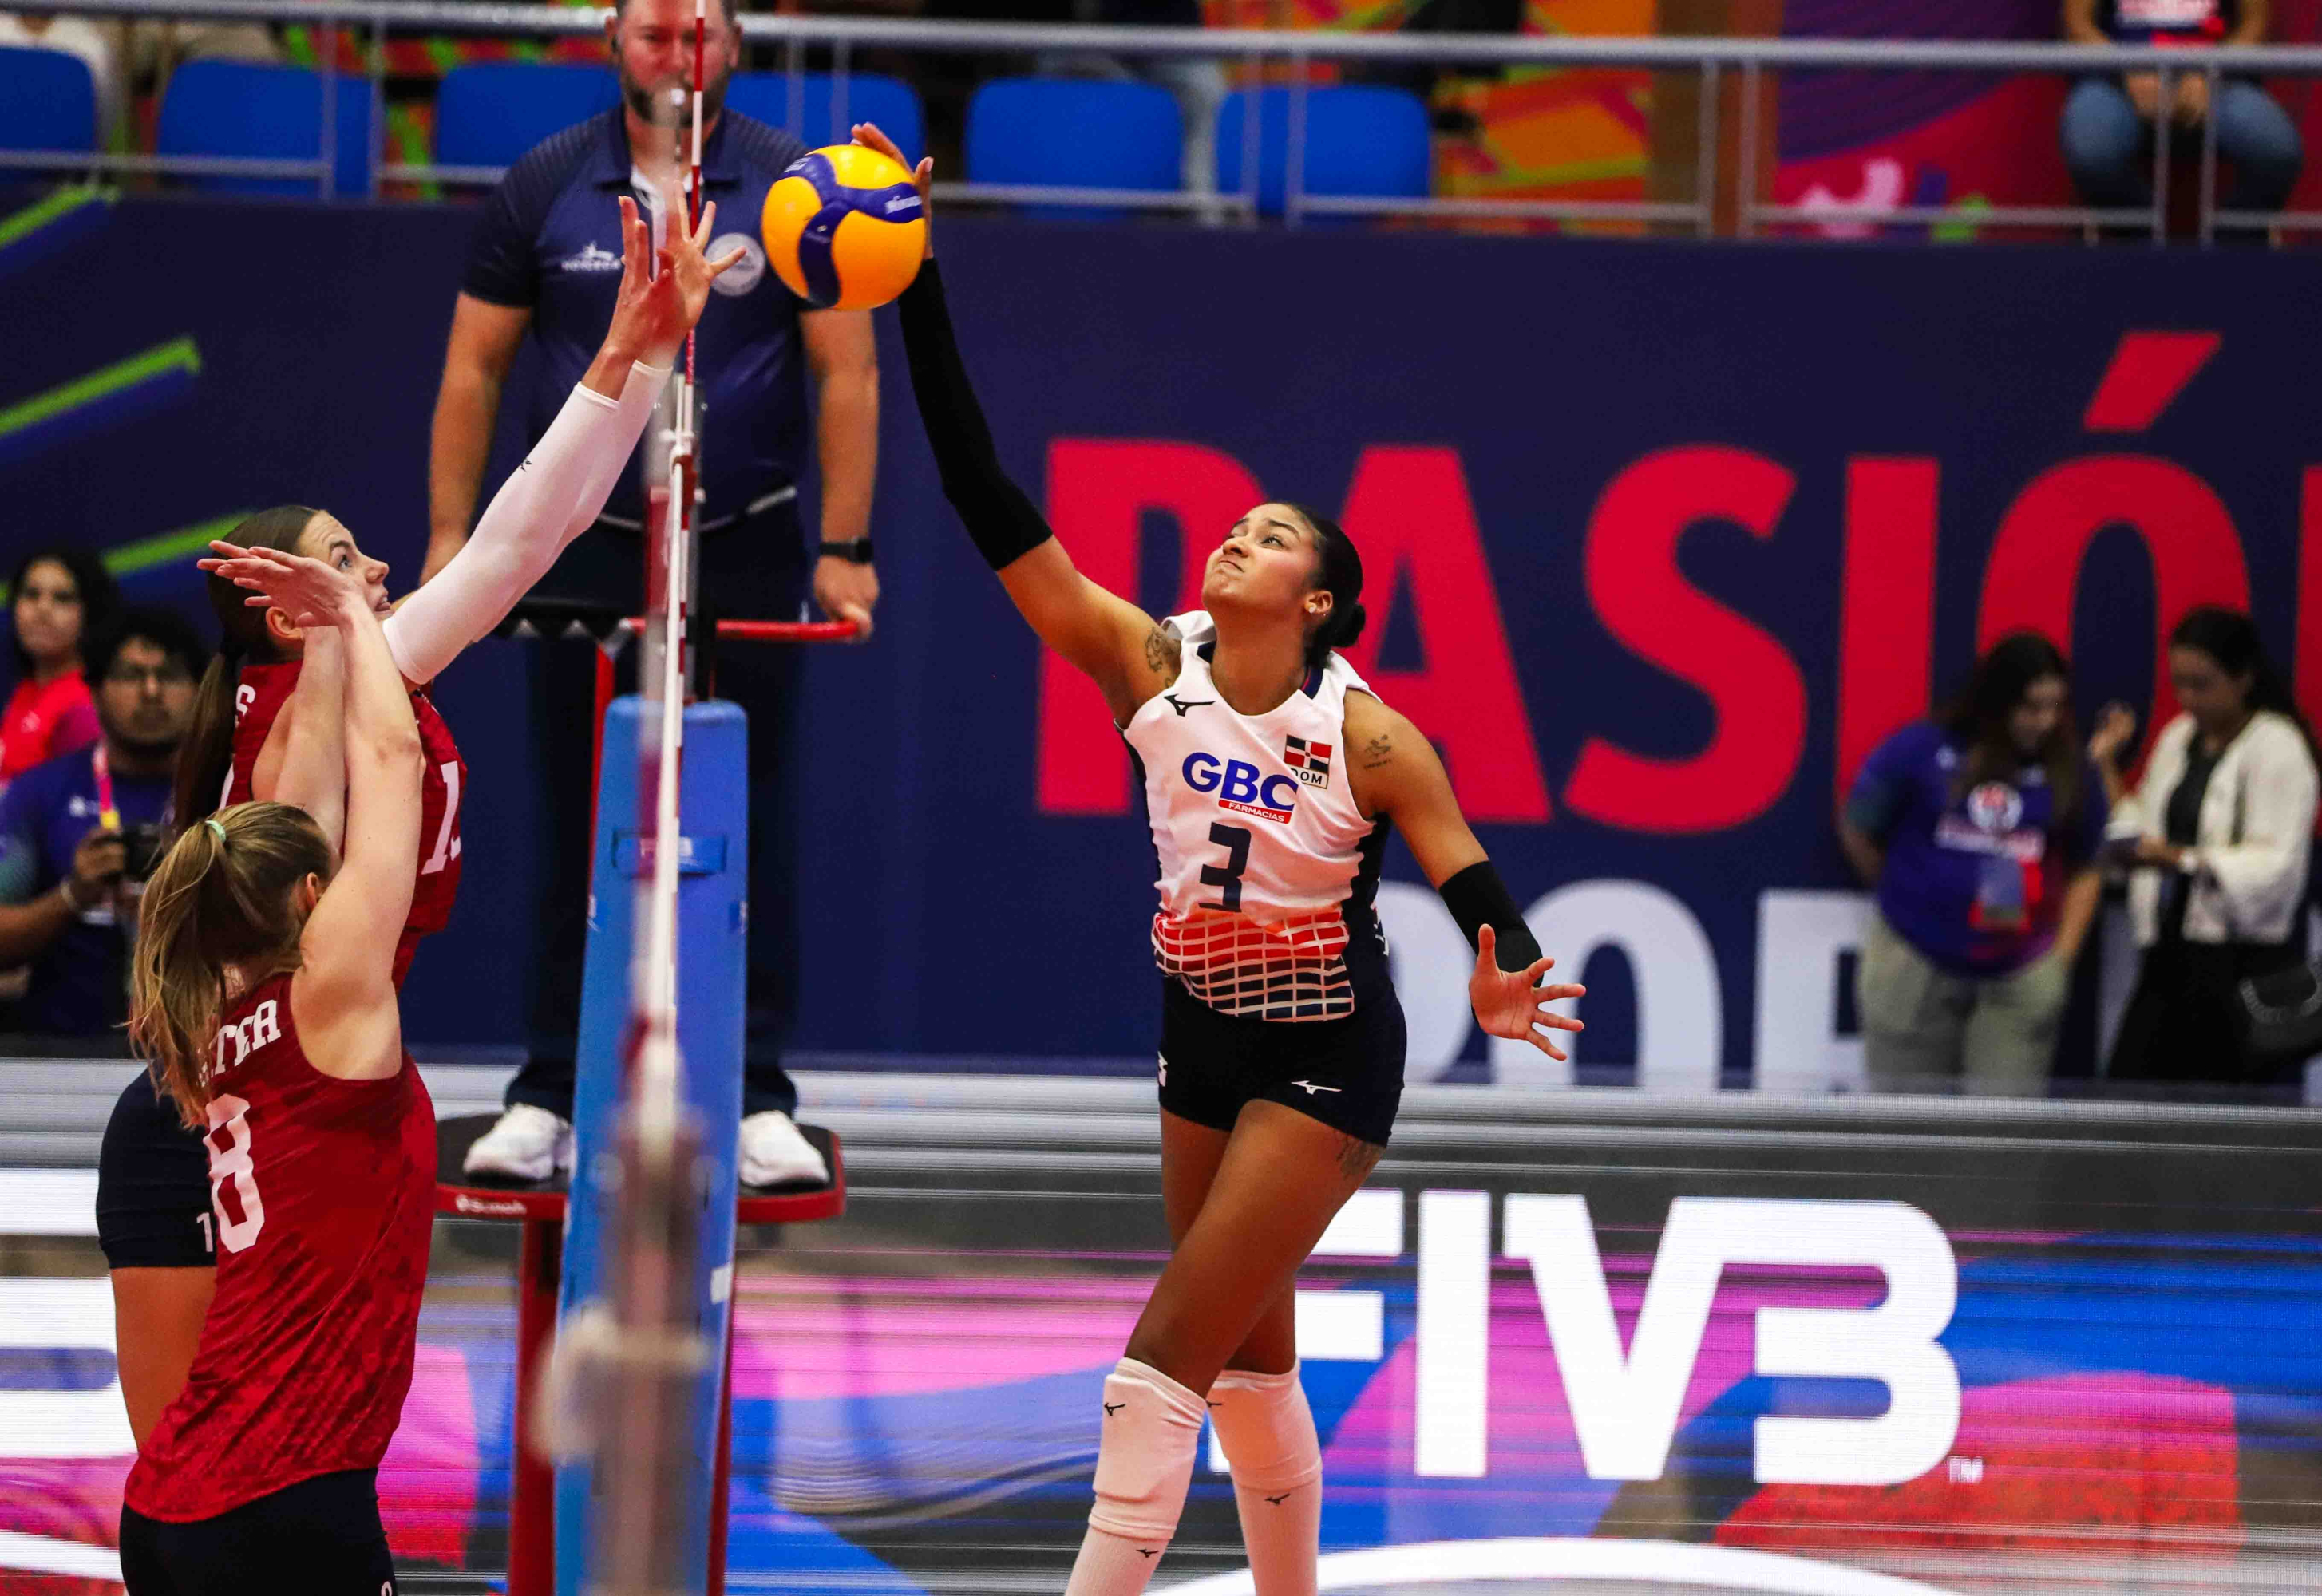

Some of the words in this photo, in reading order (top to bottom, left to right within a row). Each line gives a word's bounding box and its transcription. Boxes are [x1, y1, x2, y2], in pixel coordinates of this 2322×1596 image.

[1038, 330, 2322, 833] PASIÓ
[1182, 752, 1299, 812] GBC
[1228, 803, 1285, 823] FARMACIAS
[1198, 821, 1252, 913] 3
[203, 1093, 265, 1254] 8
